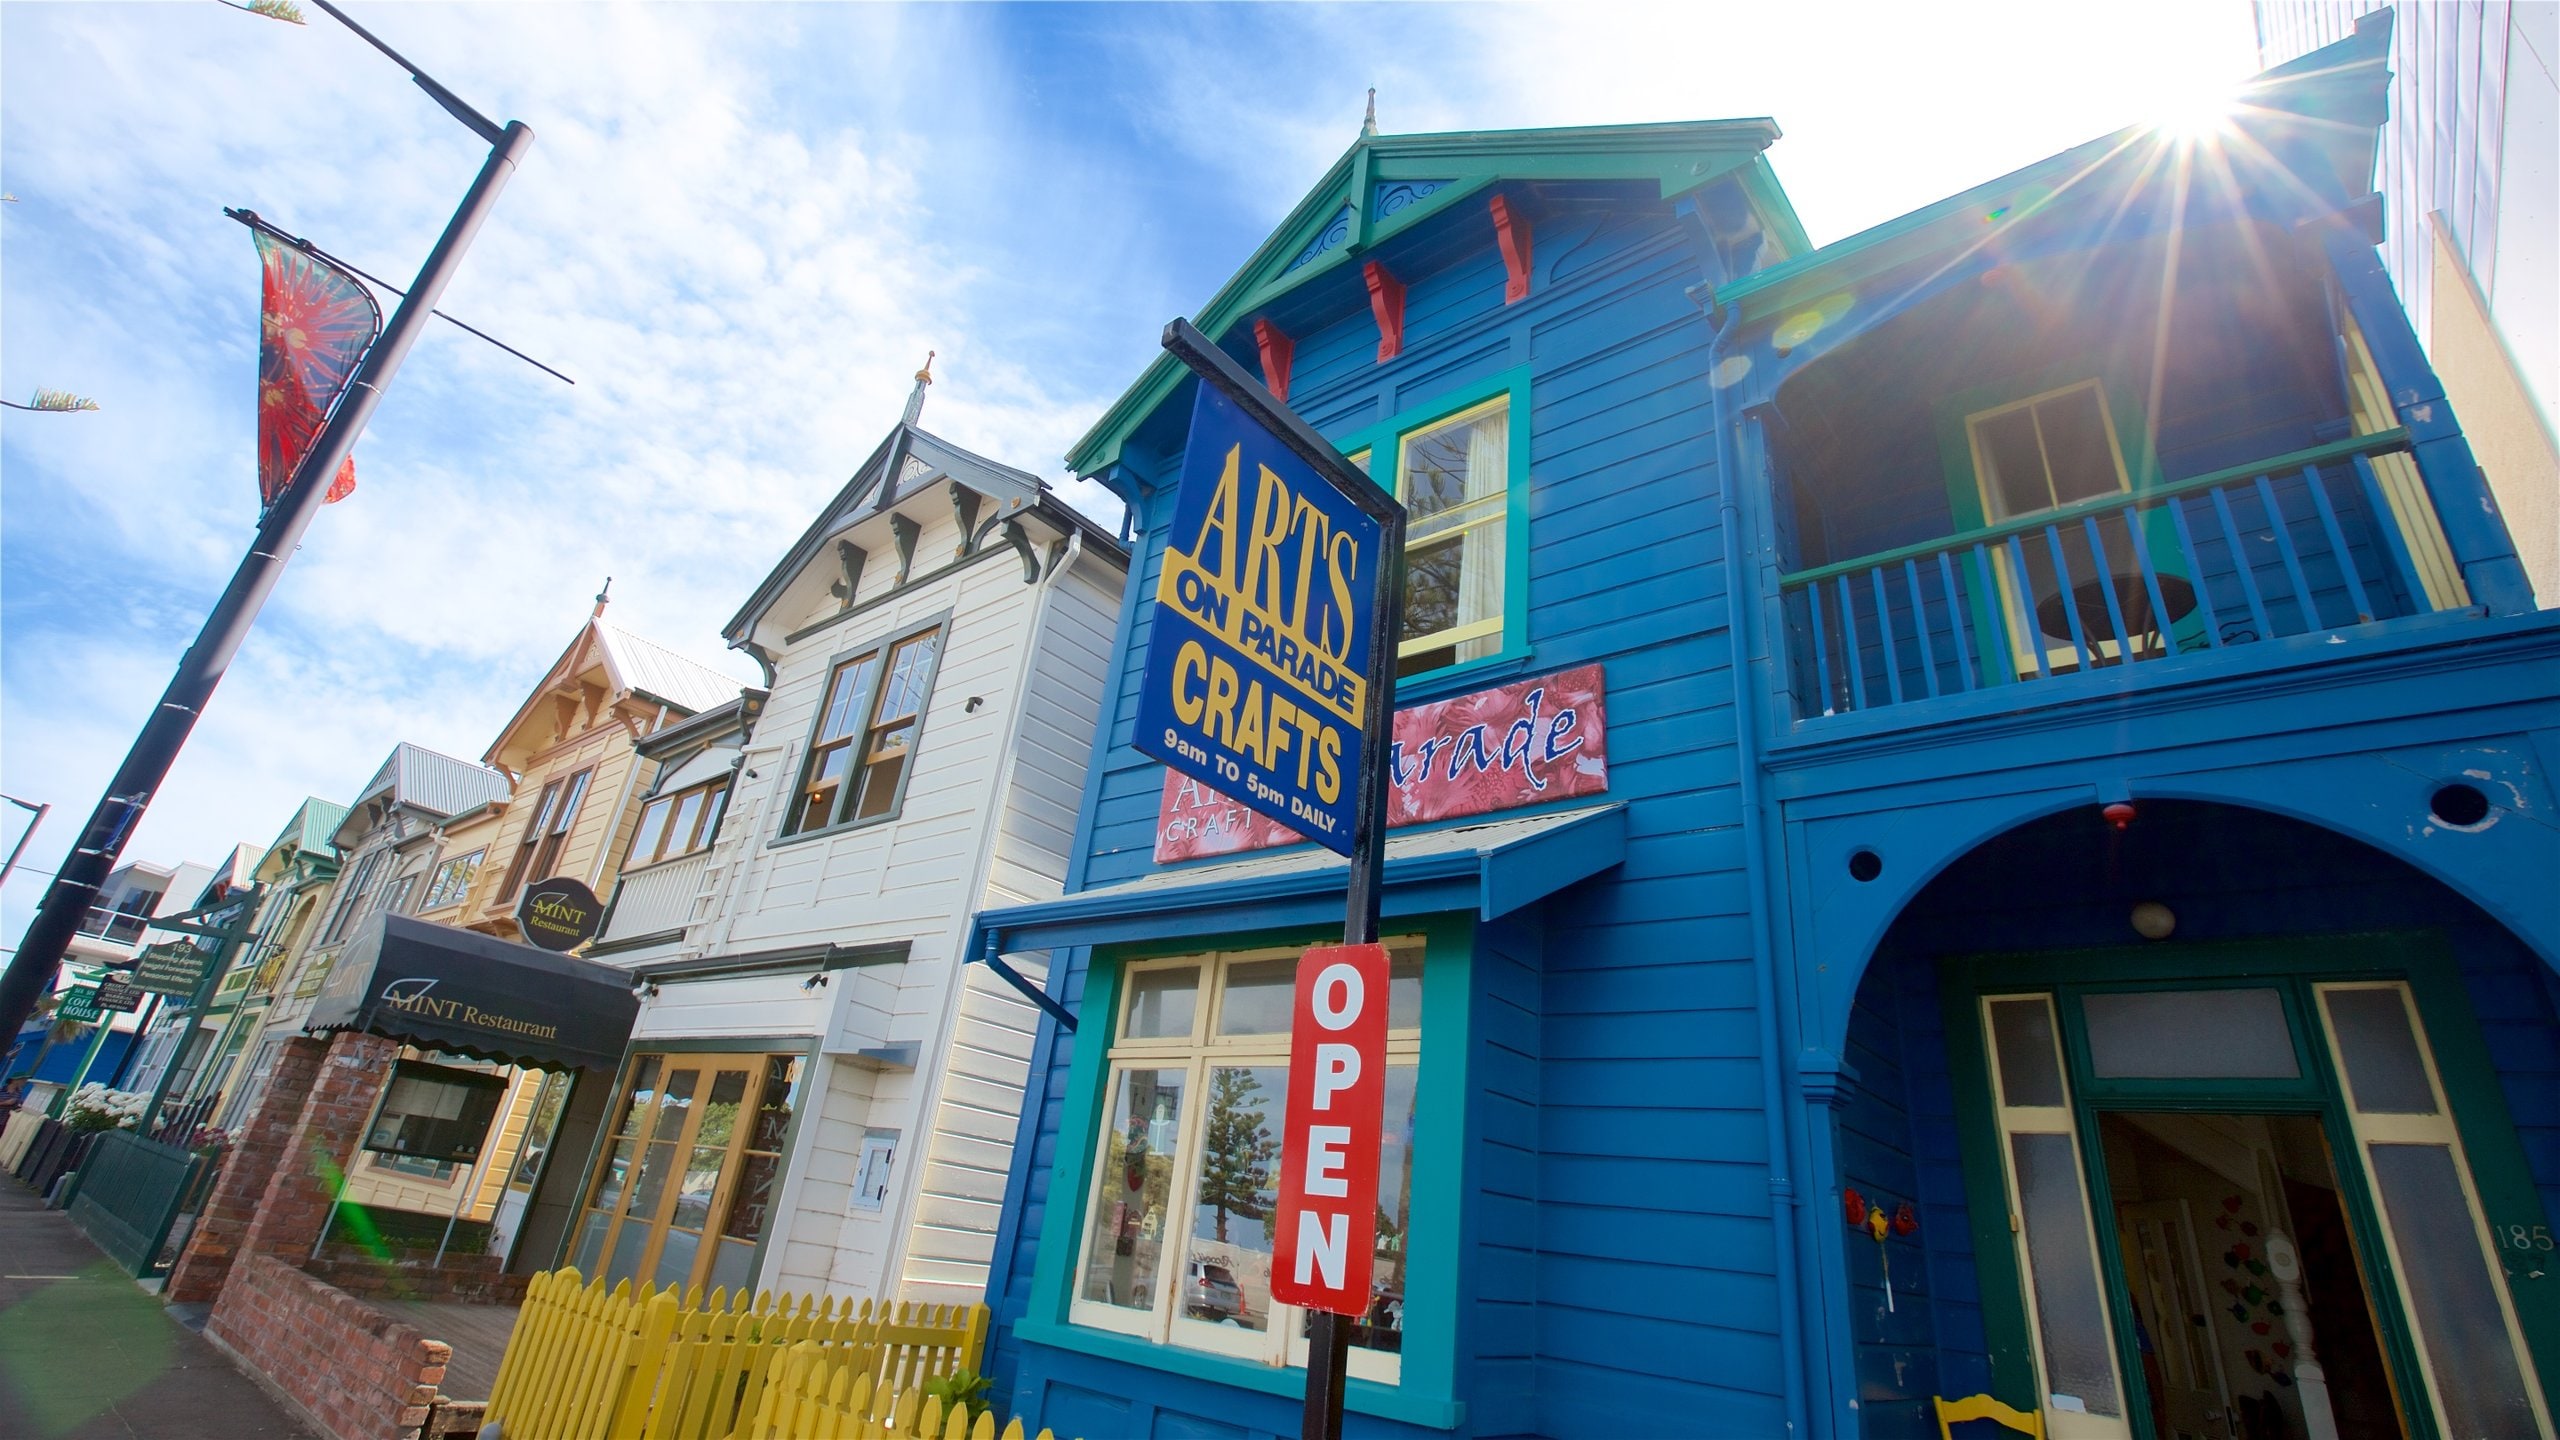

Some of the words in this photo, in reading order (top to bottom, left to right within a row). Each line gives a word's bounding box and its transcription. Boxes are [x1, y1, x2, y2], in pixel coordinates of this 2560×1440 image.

[1190, 442, 1359, 666] ARTS
[1175, 569, 1229, 632] ON
[1239, 612, 1356, 716] PARADE
[1171, 640, 1343, 806] CRAFTS
[1391, 688, 1585, 791] arade
[1164, 728, 1207, 766] 9am
[1215, 754, 1240, 782] TO
[1246, 773, 1285, 808] 5pm
[1291, 796, 1336, 833] DAILY
[172, 943, 193, 953] 193
[529, 916, 581, 937] Restaurant
[534, 898, 587, 925] MINT
[62, 1005, 99, 1019] HOUSE
[388, 988, 463, 1022] MINT
[464, 1006, 557, 1039] Restaurant
[1293, 963, 1365, 1291] OPEN
[2496, 1224, 2555, 1251] 185
